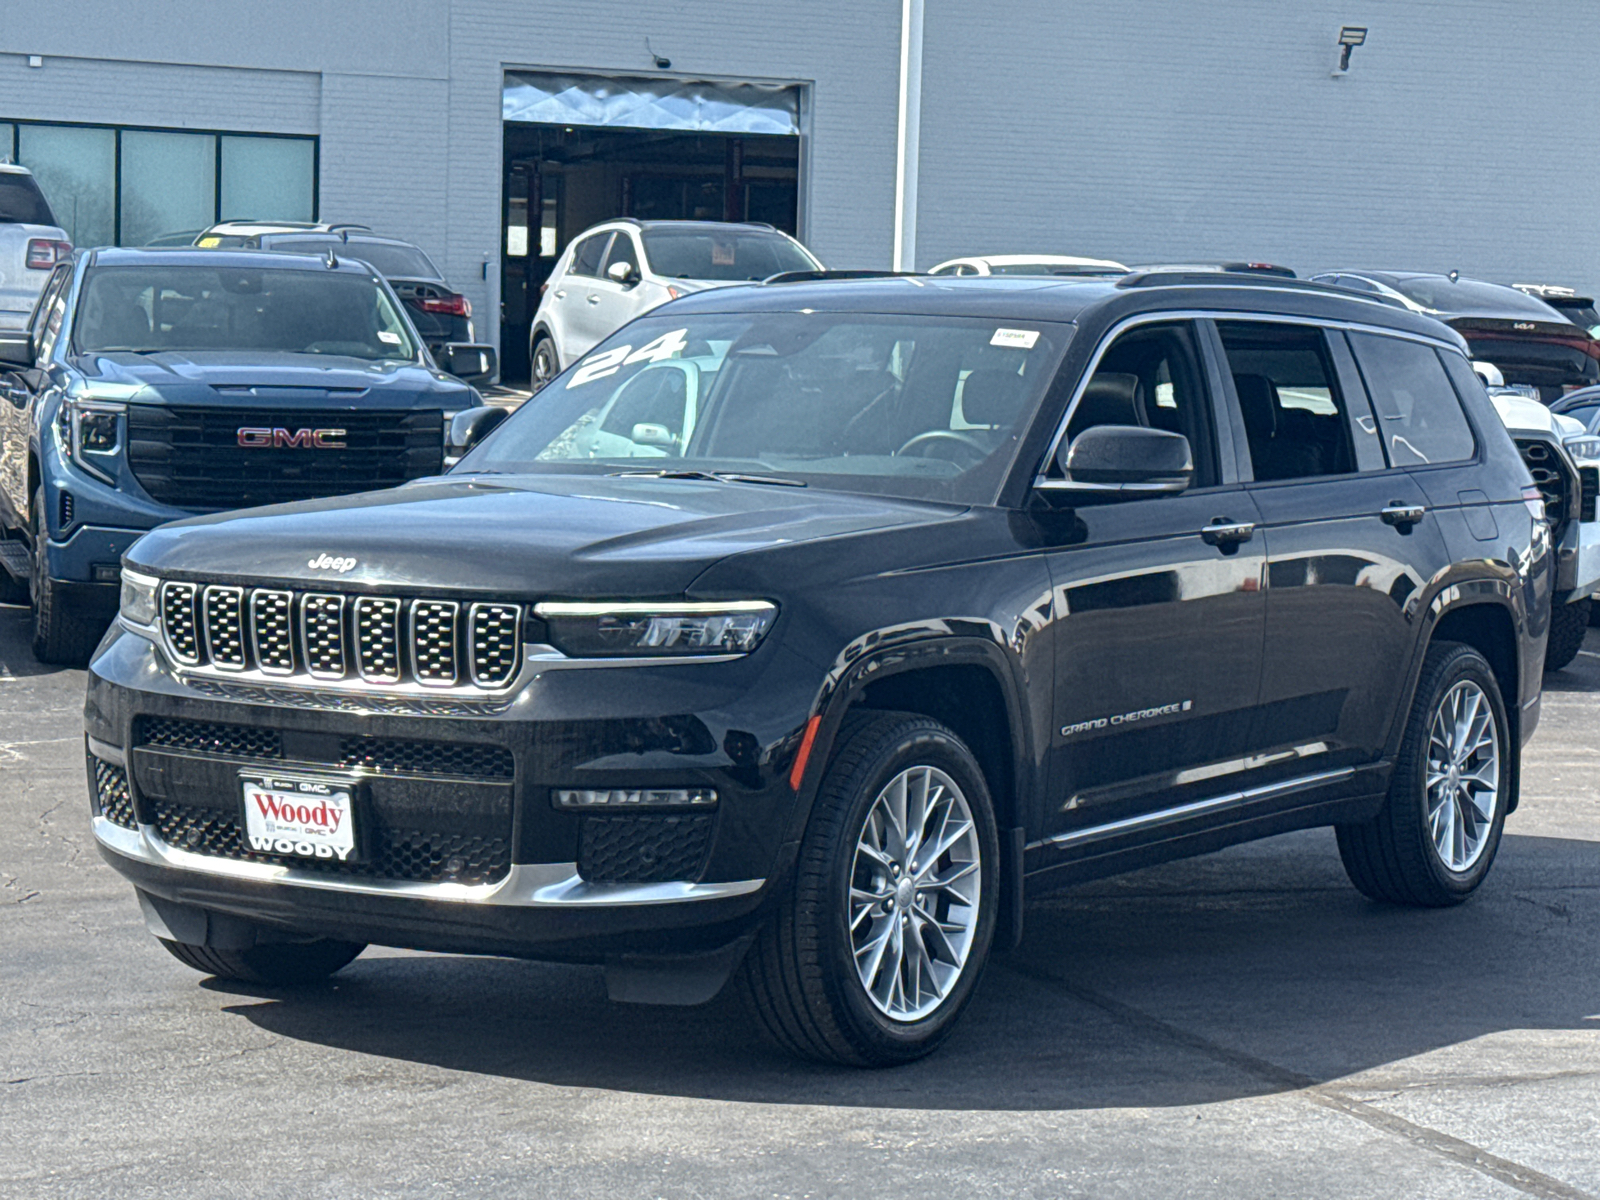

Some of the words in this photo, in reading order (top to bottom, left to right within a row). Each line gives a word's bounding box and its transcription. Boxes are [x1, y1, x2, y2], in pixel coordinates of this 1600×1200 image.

[565, 328, 688, 390] 24
[237, 427, 346, 448] GMC
[308, 553, 357, 573] Jeep
[1061, 718, 1108, 736] GRAND
[1110, 703, 1180, 725] CHEROKEE
[299, 782, 327, 794] GMC
[252, 793, 344, 834] Woody
[304, 827, 327, 836] GMC
[249, 836, 354, 861] WOODY
